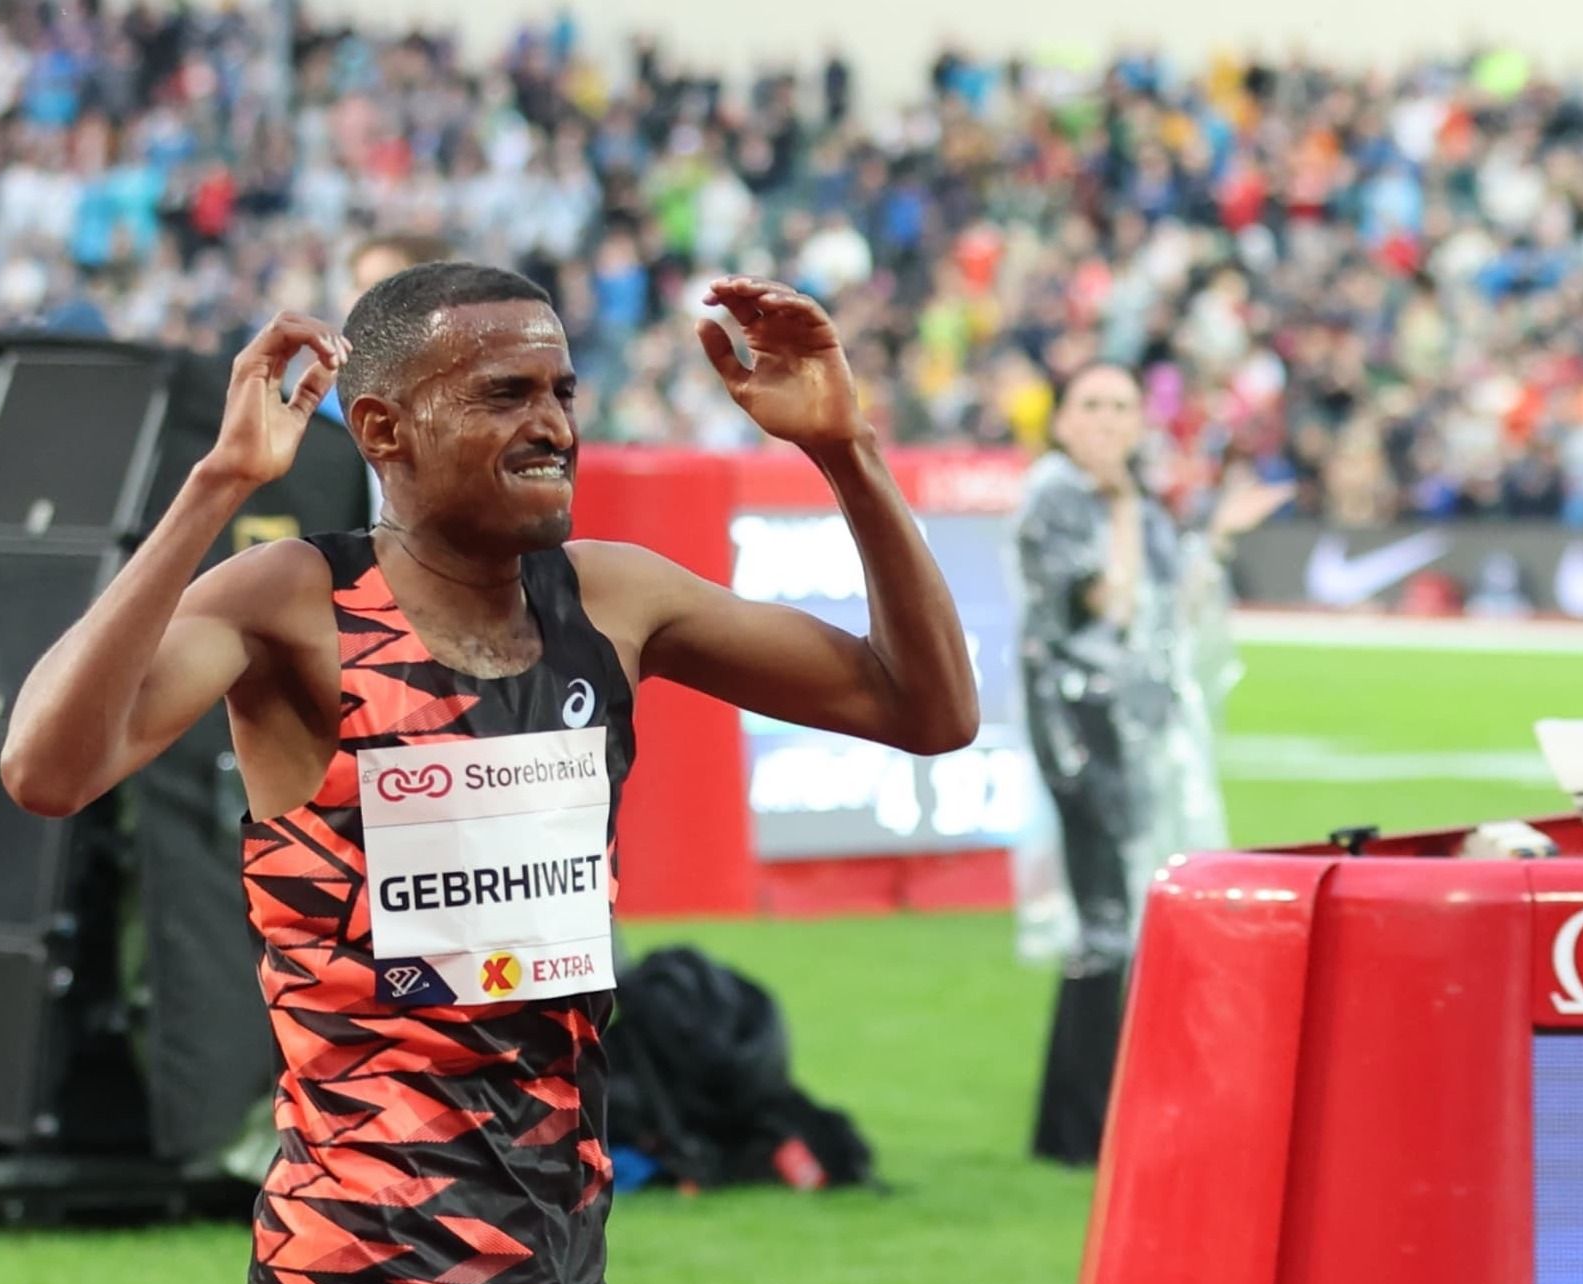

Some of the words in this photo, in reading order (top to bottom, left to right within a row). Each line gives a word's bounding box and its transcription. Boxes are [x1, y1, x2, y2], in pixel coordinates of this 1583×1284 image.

[464, 752, 597, 791] Storebrand
[379, 855, 602, 914] GEBRHIWET
[532, 954, 595, 982] EXTRA
